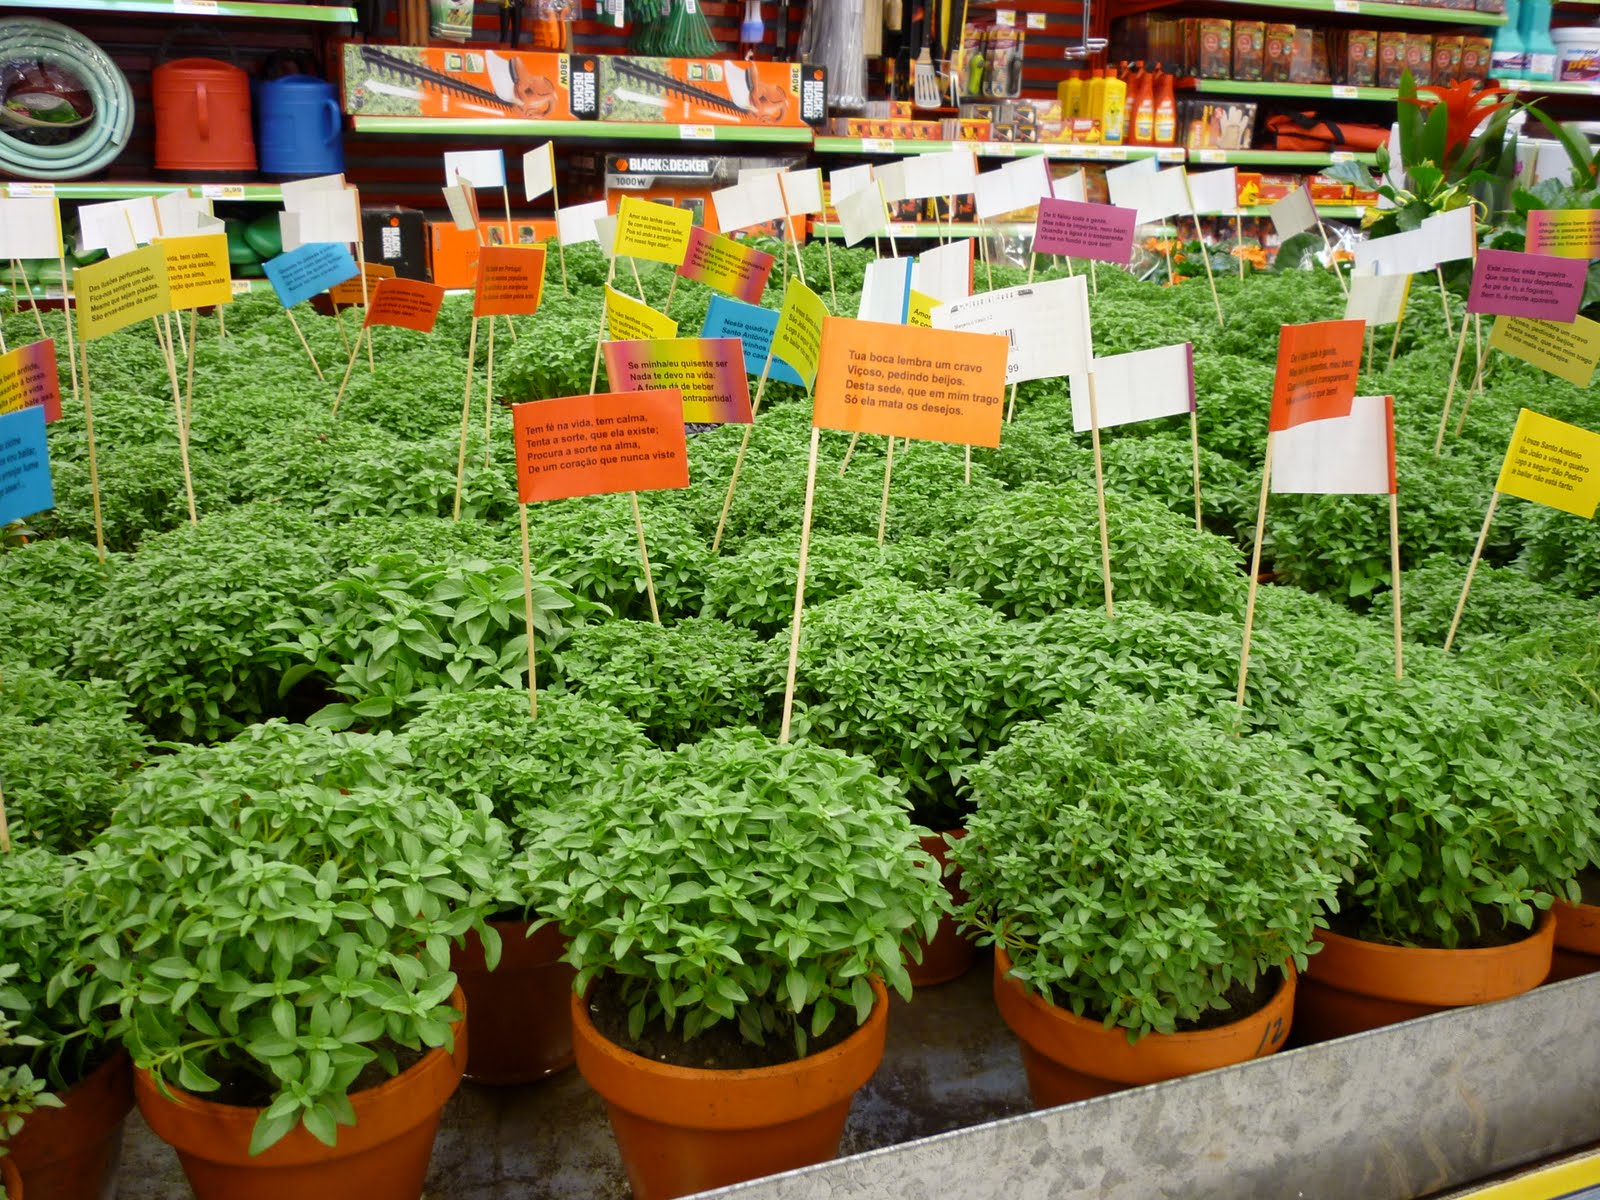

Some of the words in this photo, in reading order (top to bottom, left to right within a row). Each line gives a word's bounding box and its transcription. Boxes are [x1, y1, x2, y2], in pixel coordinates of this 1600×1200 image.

[560, 59, 568, 85] 380W
[573, 72, 584, 112] DECKER
[803, 81, 813, 118] DECKER
[629, 158, 708, 172] BLACK&DECKER
[616, 178, 645, 186] 1000W
[722, 326, 741, 336] Santo
[743, 331, 768, 342] António
[724, 317, 743, 327] Nesta
[744, 323, 768, 332] quadra
[681, 360, 713, 370] quiseste
[850, 350, 866, 361] Tua
[870, 353, 894, 364] boca
[898, 355, 931, 367] lembra
[936, 361, 950, 369] um
[954, 363, 982, 372] cravo
[848, 365, 884, 379] Viçoso,
[888, 370, 928, 381] pedindo
[932, 373, 965, 386] beijos.
[846, 379, 875, 391] Desta
[878, 384, 904, 395] sede,
[908, 388, 926, 397] que
[948, 391, 969, 400] mim
[973, 392, 999, 405] trago
[844, 394, 858, 404] Só
[861, 396, 875, 406] ela
[879, 399, 903, 408] mata
[922, 402, 963, 416] desejos.
[526, 427, 543, 435] Tem
[546, 424, 554, 433] fé
[571, 420, 593, 430] vida,
[596, 419, 613, 427] tem
[617, 415, 647, 424] calma,
[526, 438, 550, 448] Tenta
[561, 434, 587, 444] sorte,
[591, 433, 608, 443] que
[611, 430, 624, 438] ela
[628, 426, 659, 436] existe;
[528, 451, 563, 460] Procura
[574, 446, 597, 455] sorte
[615, 442, 640, 451] alma,
[529, 465, 540, 473] De
[560, 459, 597, 470] coração
[600, 458, 617, 468] que
[621, 455, 650, 463] nunca
[652, 450, 675, 460] viste
